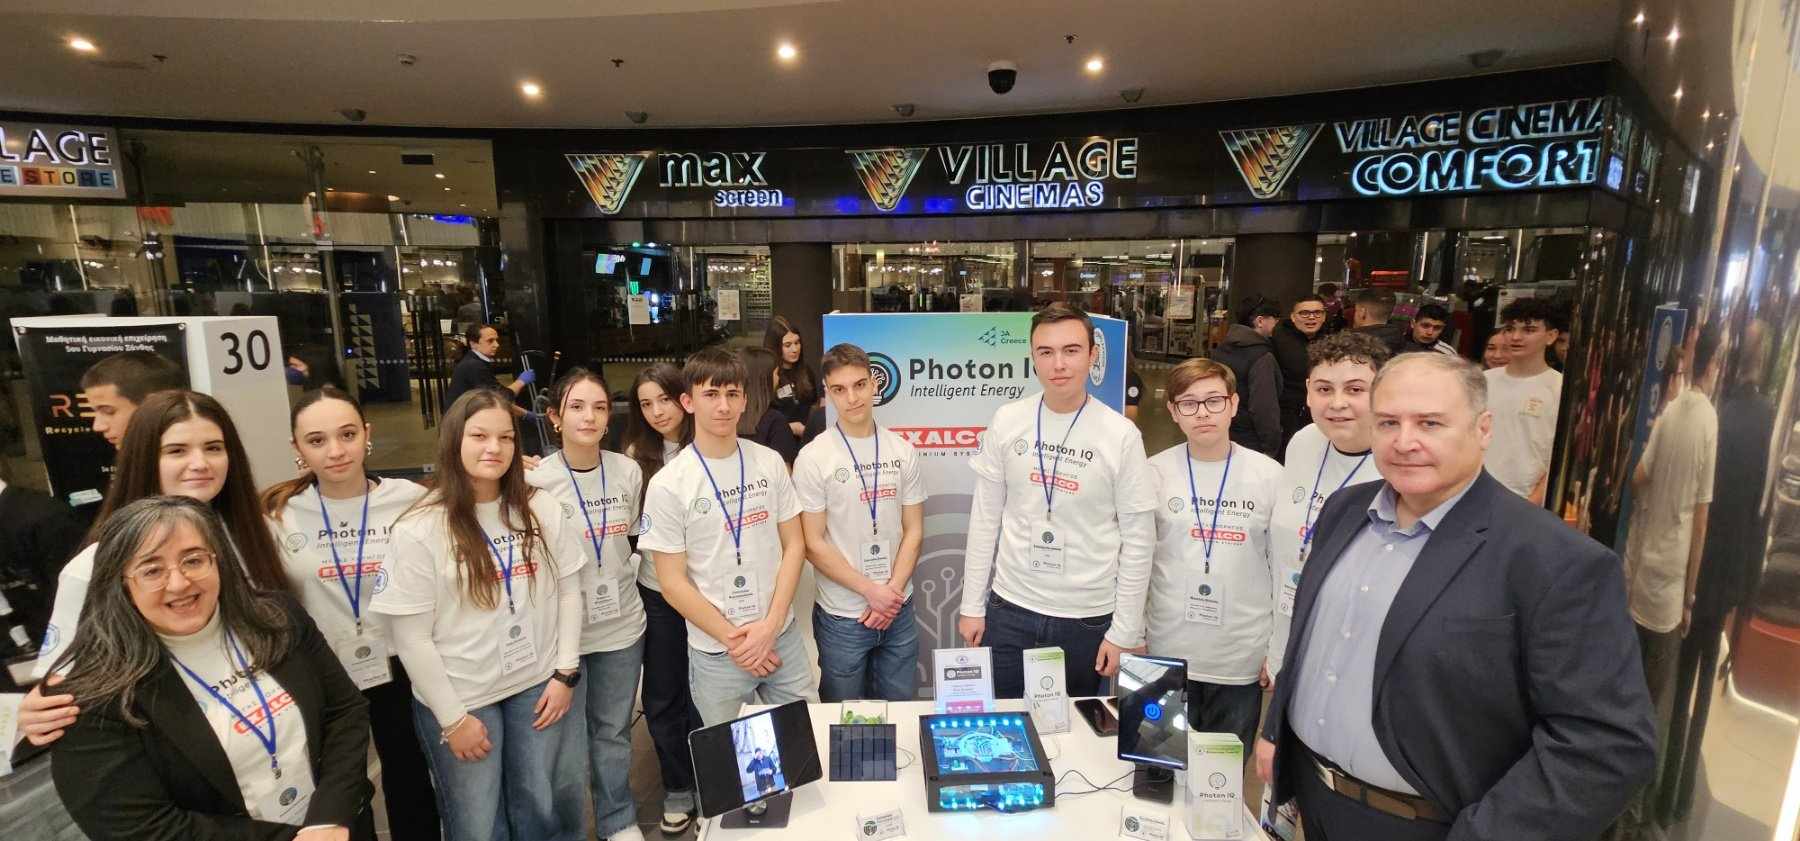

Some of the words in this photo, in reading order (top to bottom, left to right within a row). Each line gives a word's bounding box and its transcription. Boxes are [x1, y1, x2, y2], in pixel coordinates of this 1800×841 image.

[1335, 110, 1463, 153] VILLAGE
[658, 151, 768, 187] max
[937, 137, 1139, 184] VILLAGE
[1352, 139, 1600, 196] COMFORT
[23, 169, 113, 187] STORE
[714, 189, 783, 207] screen
[966, 181, 1104, 210] CINEMAS
[220, 329, 270, 375] 30
[909, 358, 1014, 381] Photon
[1023, 356, 1037, 380] I
[910, 384, 977, 400] Intelligent
[980, 384, 1025, 399] Energy
[901, 430, 980, 445] XALC
[1034, 440, 1076, 457] Photon
[1080, 449, 1095, 461] IQ
[891, 459, 902, 469] IQ
[756, 478, 769, 489] IQ
[1191, 496, 1238, 508] Phoon
[1242, 500, 1255, 512] IQ
